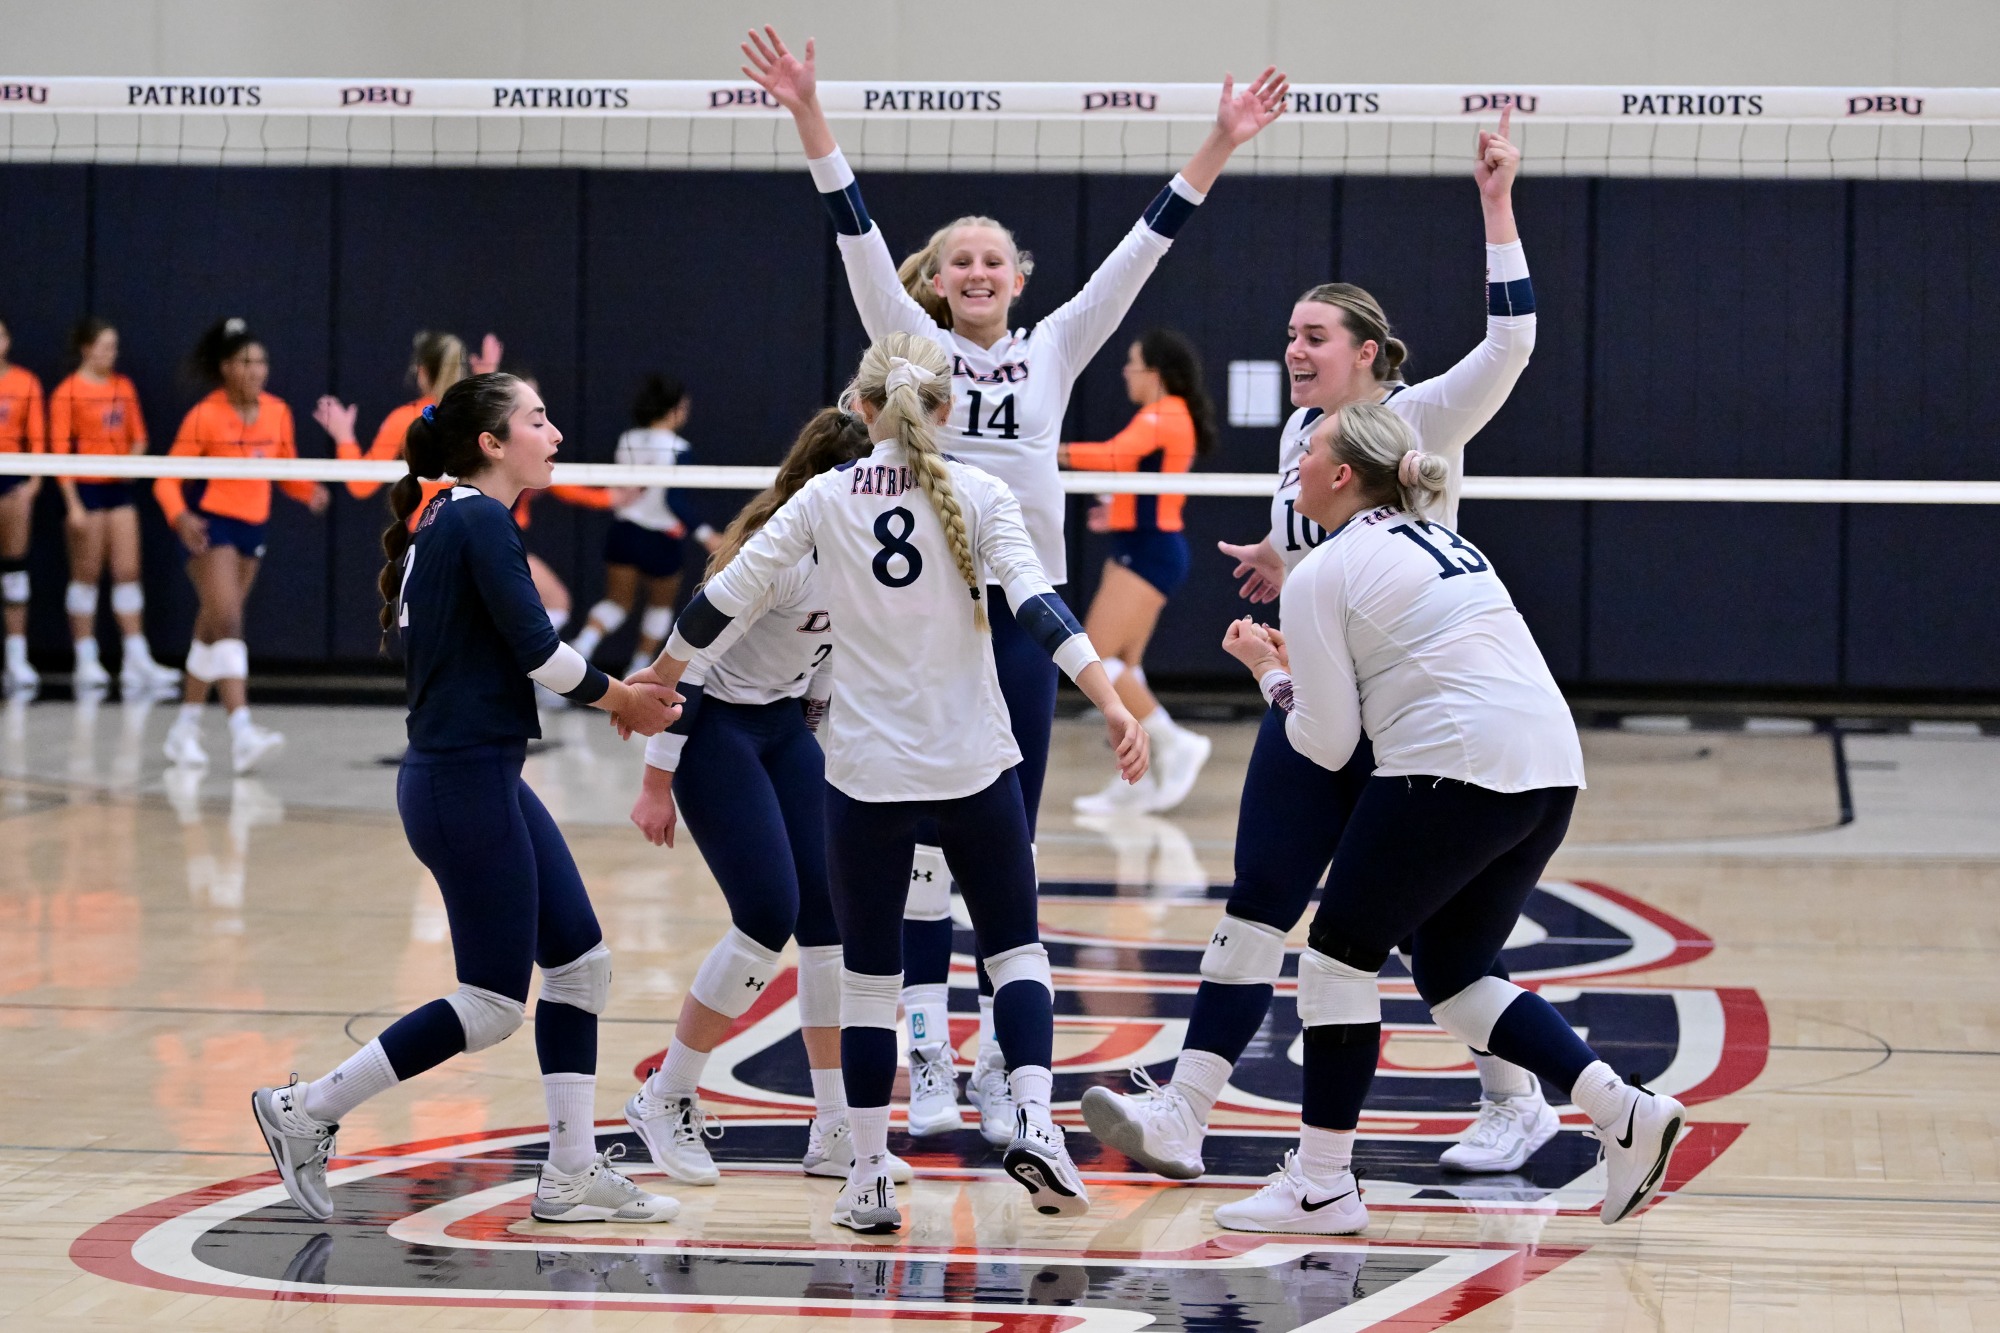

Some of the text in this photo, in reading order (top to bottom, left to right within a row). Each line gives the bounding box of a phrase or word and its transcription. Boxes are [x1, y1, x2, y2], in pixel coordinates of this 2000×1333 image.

[0, 84, 49, 105] BU
[127, 85, 262, 106] PATRIOTS
[340, 86, 413, 107] DBU
[493, 88, 629, 109] PATRIOTS
[863, 90, 1002, 111] PATRIOTS
[1082, 91, 1158, 112] DBU
[1270, 92, 1380, 113] TRIOTS
[1461, 93, 1538, 114] DBU
[1621, 94, 1763, 116] PATRIOTS
[1846, 96, 1925, 116] DBU
[962, 390, 1019, 439] 14
[851, 465, 919, 496] PATRI
[872, 506, 922, 588] 8
[1285, 499, 1327, 551] 10
[1387, 520, 1488, 580] 13
